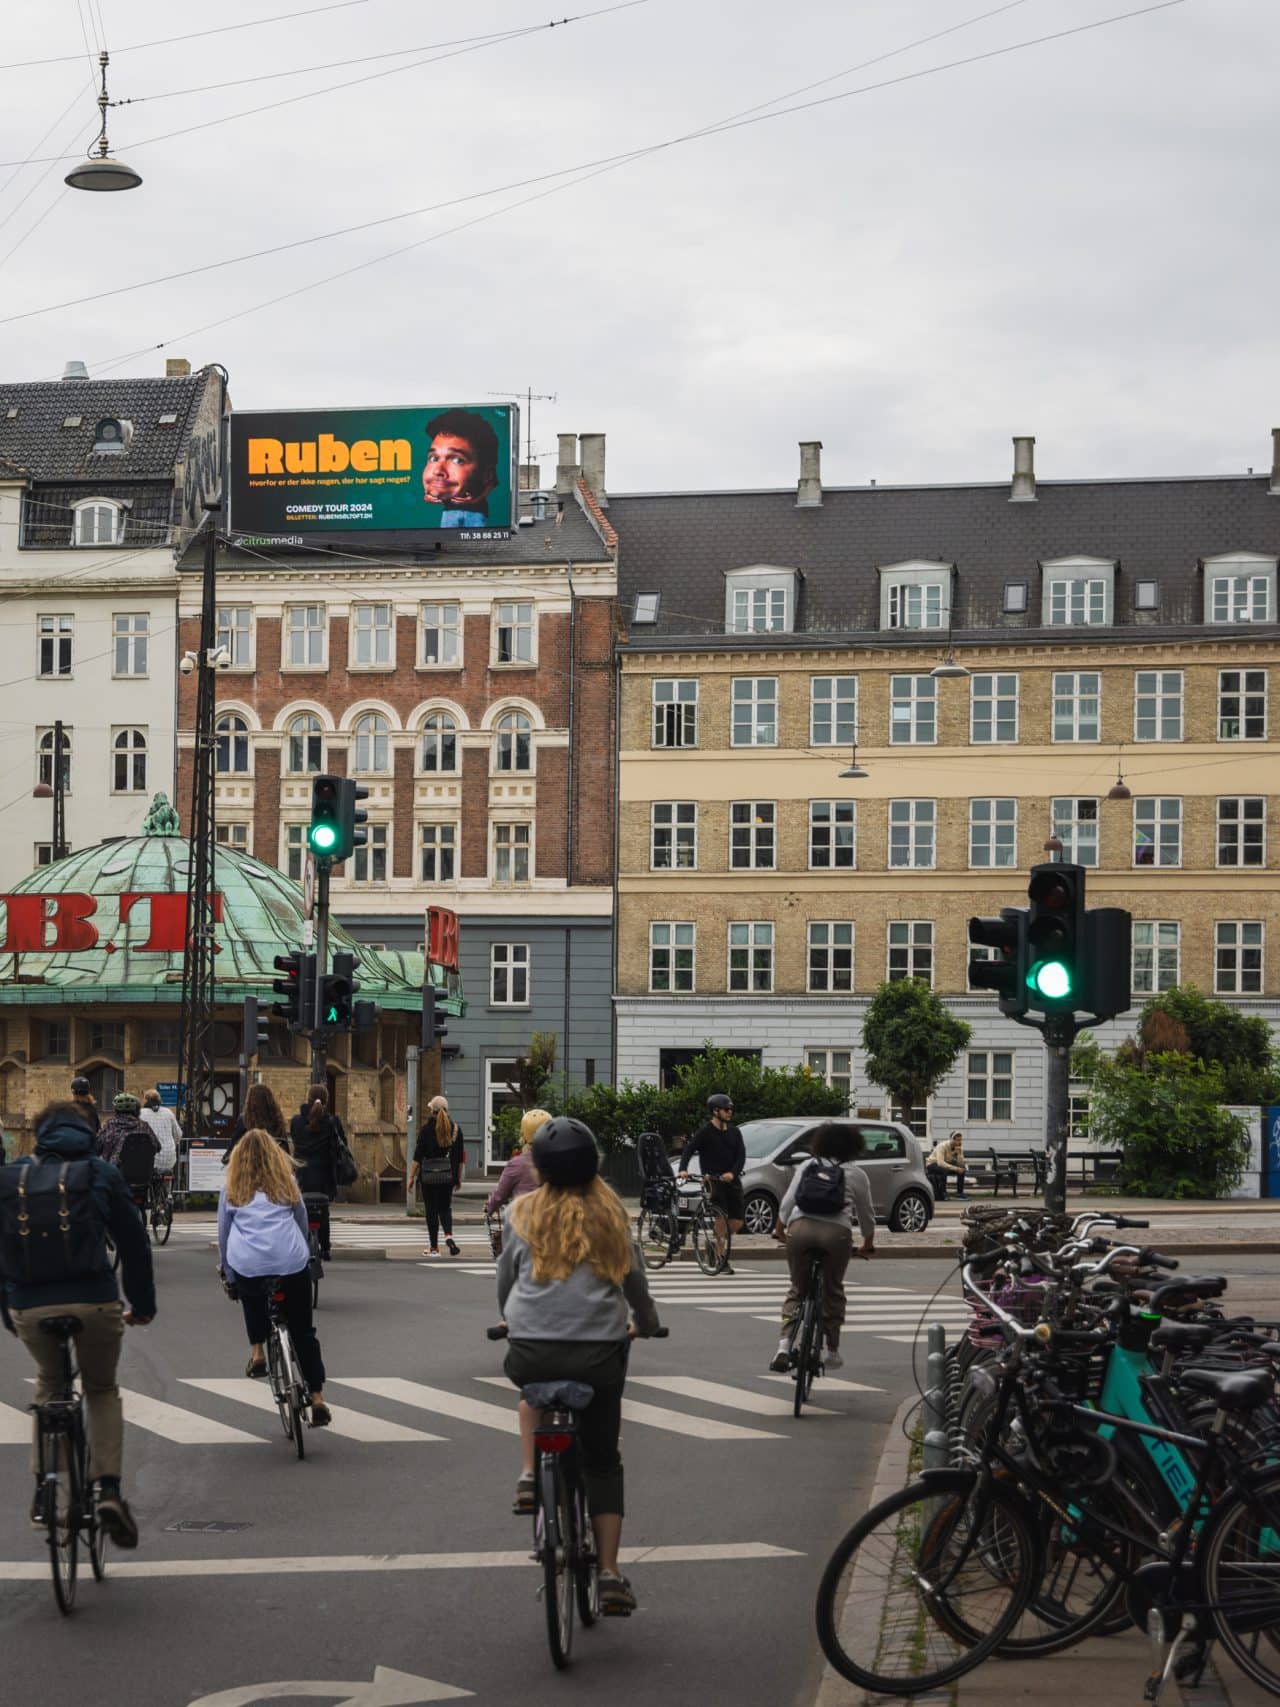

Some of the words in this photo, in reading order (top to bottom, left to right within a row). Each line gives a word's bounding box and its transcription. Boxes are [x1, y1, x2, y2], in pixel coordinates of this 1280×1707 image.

[248, 433, 412, 474] Ruben
[286, 505, 323, 513] COMEDY
[325, 504, 349, 512] TOUR
